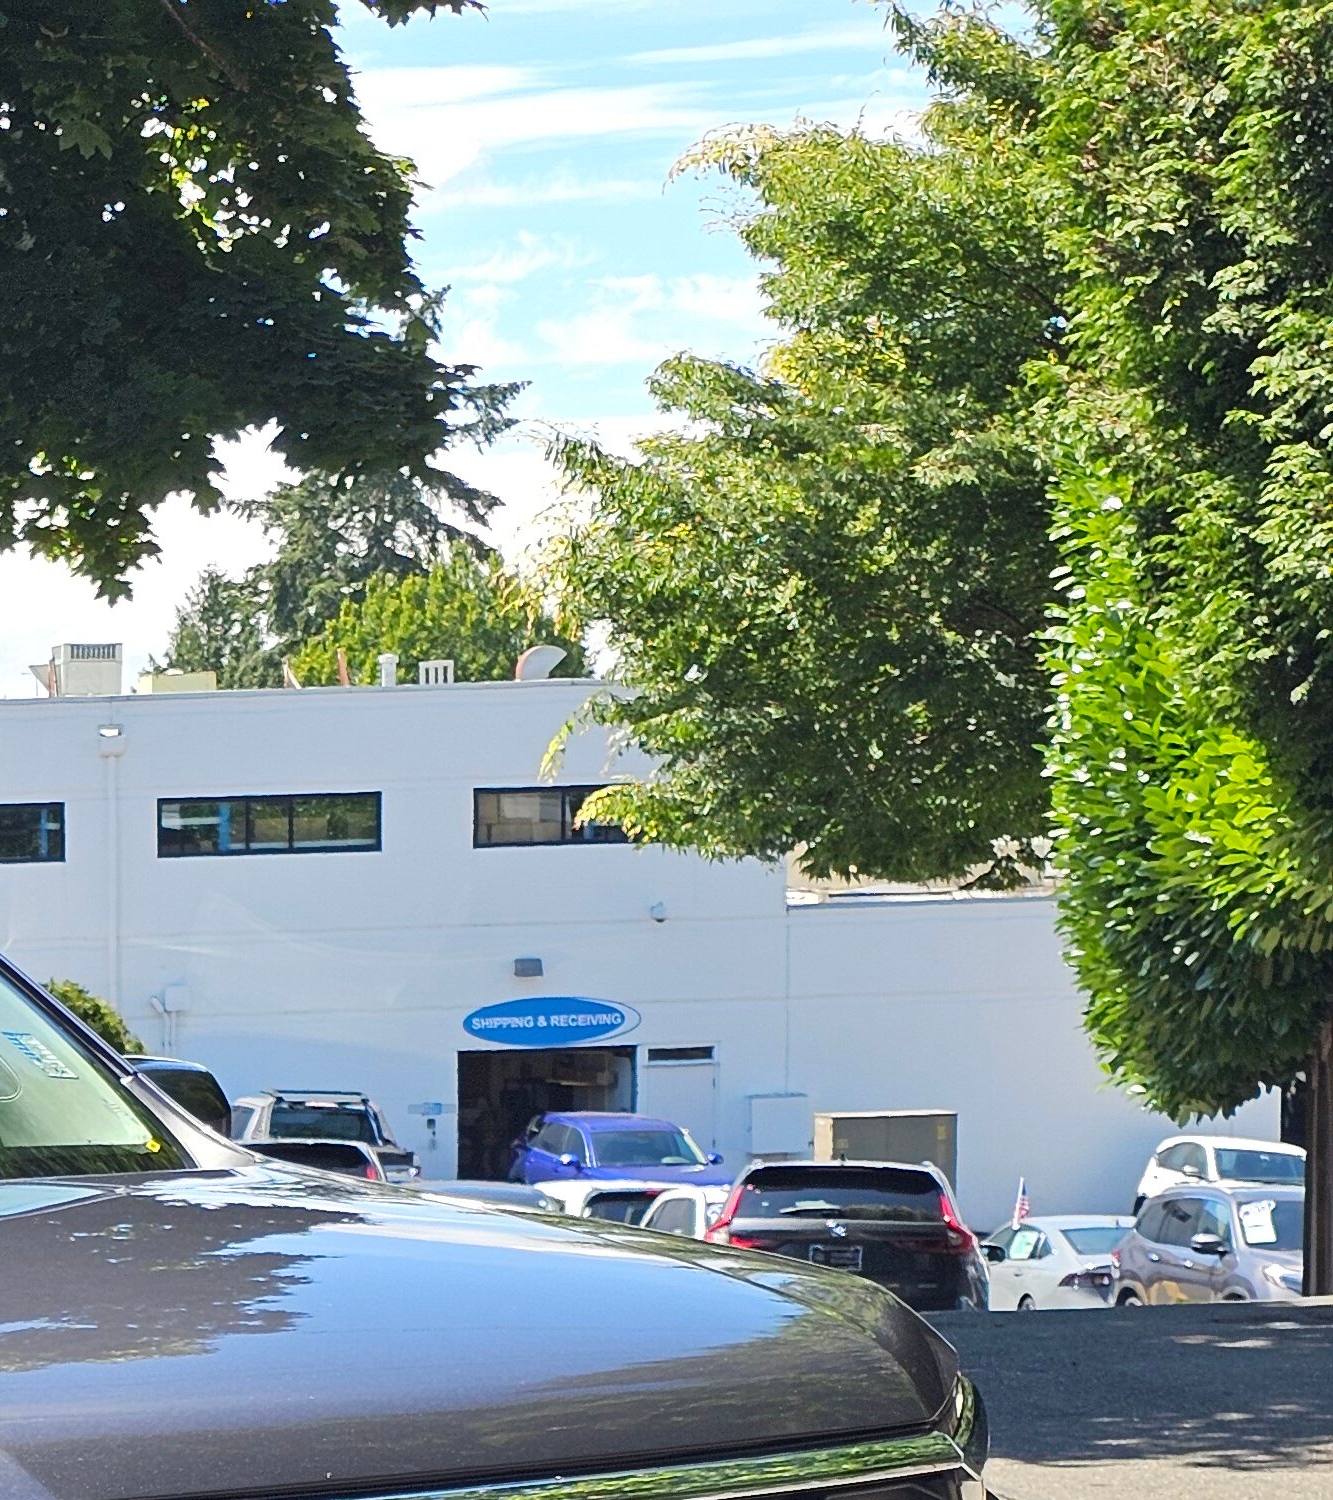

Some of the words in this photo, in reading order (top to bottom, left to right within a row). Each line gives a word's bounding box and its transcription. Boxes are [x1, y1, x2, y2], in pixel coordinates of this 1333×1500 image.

[471, 1015, 534, 1030] SHIPPING
[537, 1015, 547, 1028] &
[550, 1012, 622, 1027] RECEIVING
